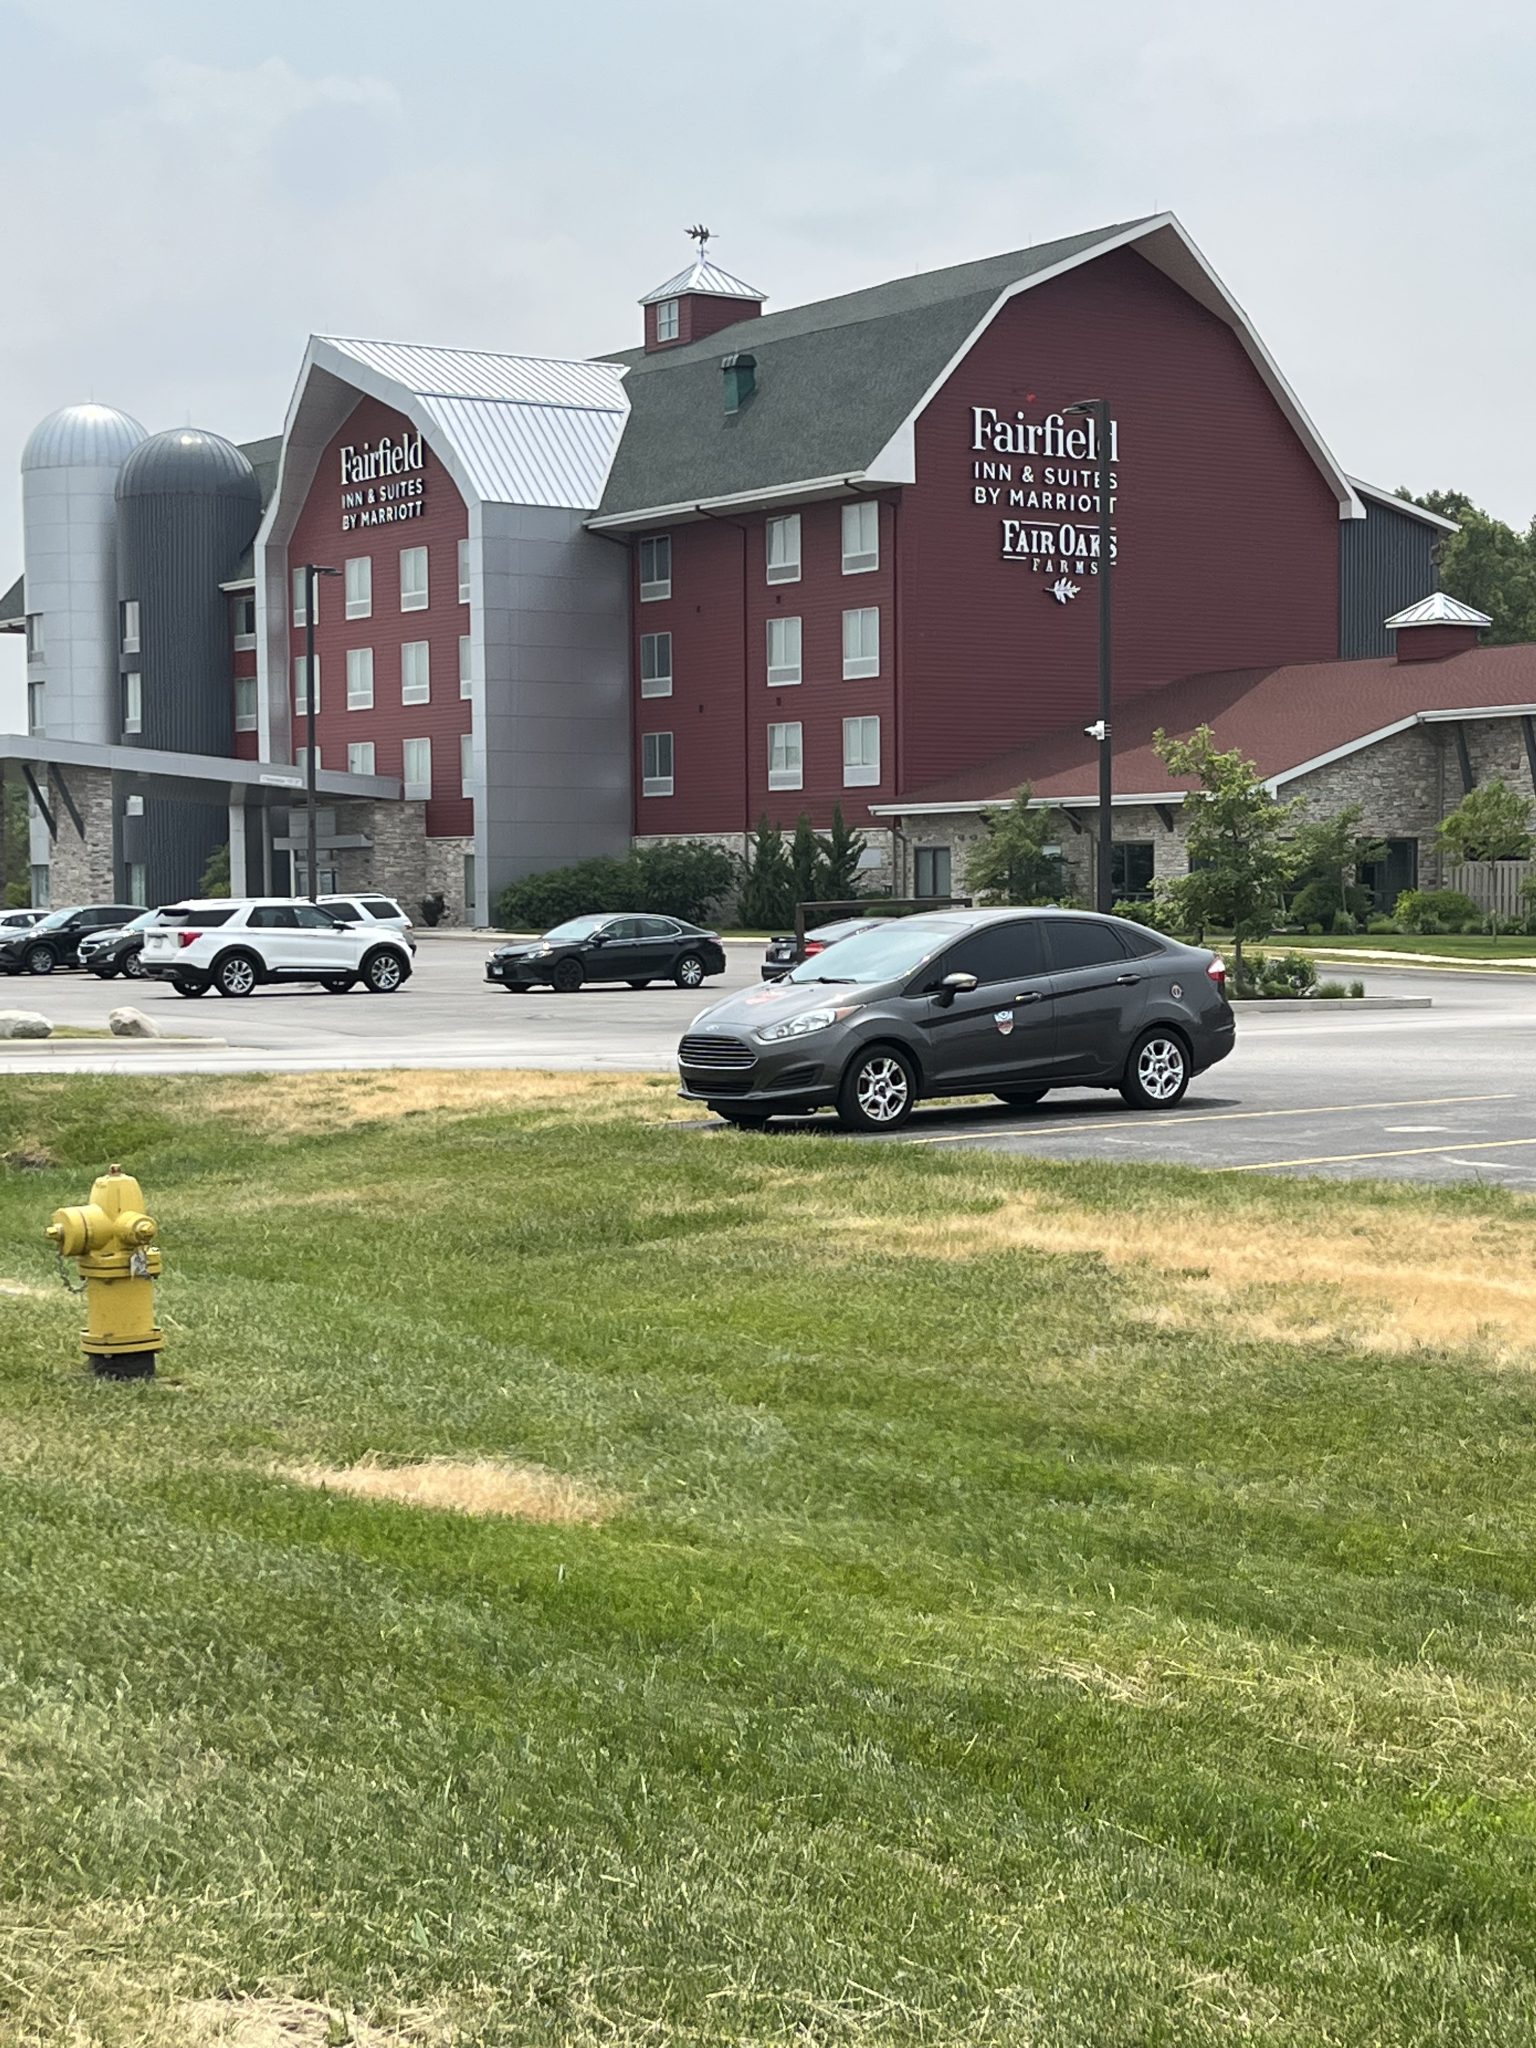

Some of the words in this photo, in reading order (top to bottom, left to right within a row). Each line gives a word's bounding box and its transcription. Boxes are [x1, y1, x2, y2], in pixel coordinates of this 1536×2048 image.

[972, 406, 1120, 462] Fairfield
[340, 430, 424, 485] Fairfield
[974, 461, 1012, 481] INN
[1022, 465, 1034, 483] &
[1044, 467, 1118, 489] SUITES
[341, 491, 363, 509] INN
[367, 488, 375, 504] &
[380, 478, 422, 501] SUITES
[975, 486, 1000, 505] BY
[1009, 489, 1117, 514] MARRIOTT
[342, 513, 357, 530] BY
[361, 500, 422, 527] MARRIOTT
[1002, 519, 1055, 554] FAIR
[1032, 558, 1098, 575] FARMS
